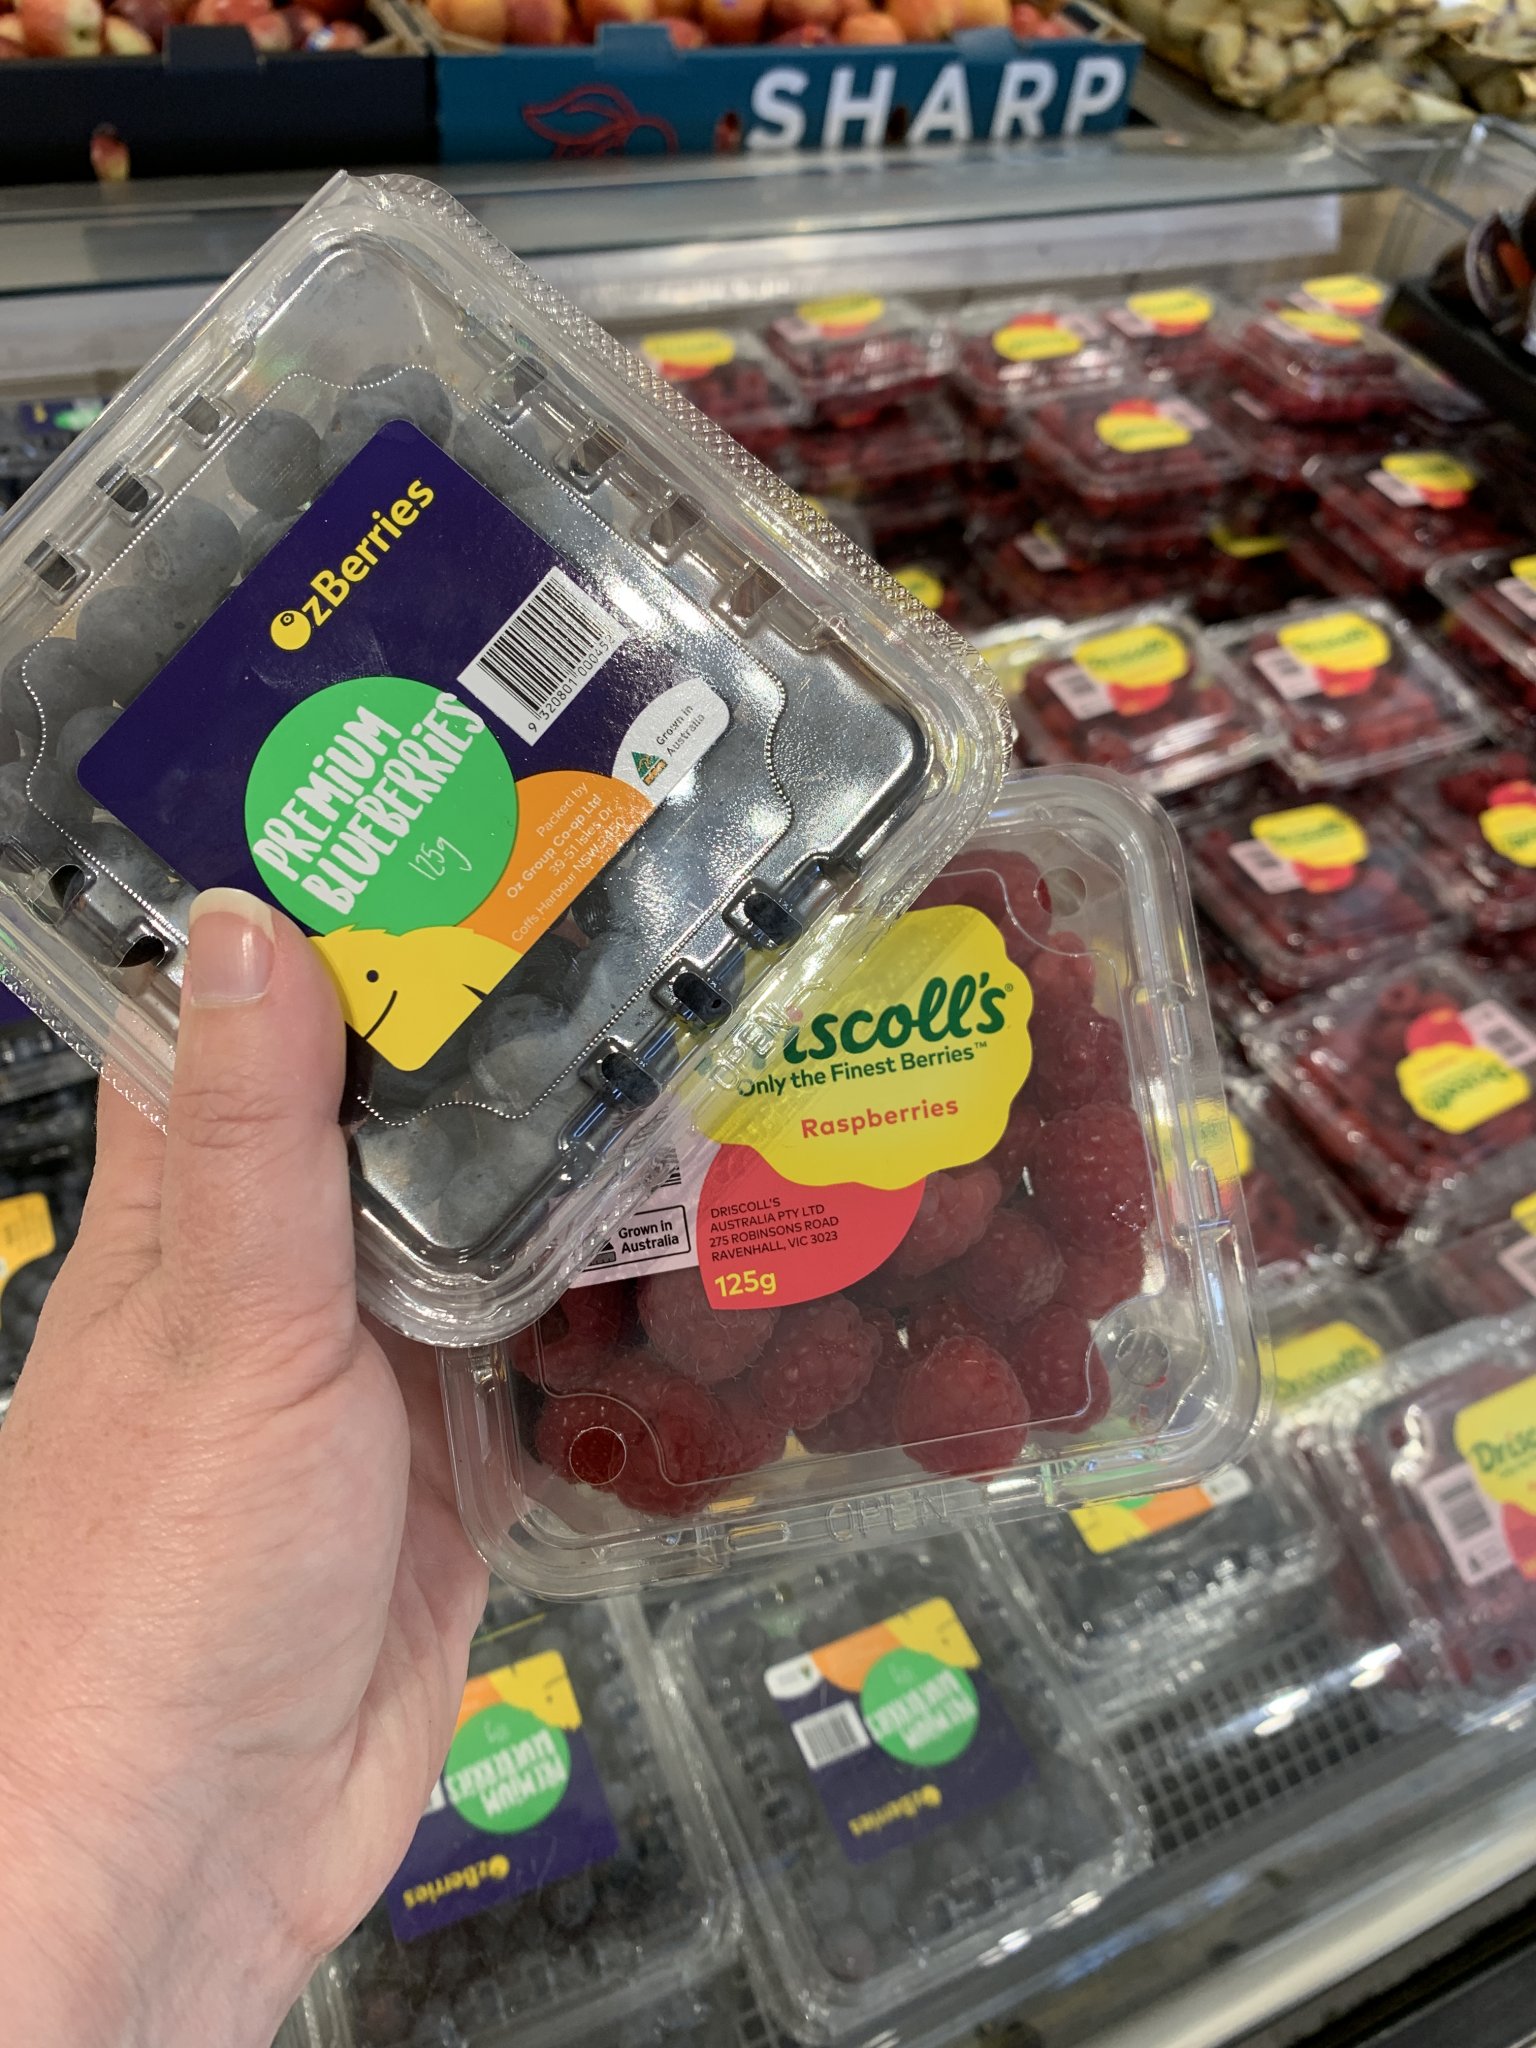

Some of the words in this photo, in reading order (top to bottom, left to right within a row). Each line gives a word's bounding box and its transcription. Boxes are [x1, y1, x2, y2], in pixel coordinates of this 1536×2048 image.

[744, 55, 1127, 151] SHARP
[270, 479, 435, 651] OzBerries
[539, 677, 578, 722] 320801
[577, 633, 617, 678] 000452
[655, 713, 685, 747] Grown
[679, 703, 695, 722] in
[665, 712, 706, 757] Australia
[536, 796, 575, 839] Packed
[571, 782, 591, 801] by
[408, 836, 474, 882] 125g
[506, 880, 526, 900] Oz
[522, 845, 556, 883] Group
[552, 811, 587, 848] Co-op
[583, 792, 604, 816] Ltd
[549, 843, 580, 878] 39-51
[575, 820, 603, 850] Isles
[511, 912, 541, 944] Coffs
[536, 872, 578, 916] Harbour
[737, 1073, 786, 1099] Only
[789, 1066, 827, 1091] the
[831, 1056, 898, 1084] Finest
[800, 1098, 960, 1140] Raspberries
[617, 1223, 659, 1240] Grown
[659, 1219, 674, 1232] in
[709, 1212, 776, 1233] AUSTRALIA
[778, 1208, 800, 1223] PTY
[802, 1203, 826, 1219] LTD
[710, 1197, 782, 1219] DRISCOLL'S
[620, 1232, 681, 1255] Australia
[709, 1234, 730, 1248] 275
[731, 1221, 803, 1244] ROBINSONS
[804, 1215, 840, 1231] ROAD
[711, 1238, 788, 1262] RAVENHALL,
[788, 1233, 809, 1248] VIC
[810, 1229, 839, 1245] 3023
[713, 1268, 777, 1298] 125g
